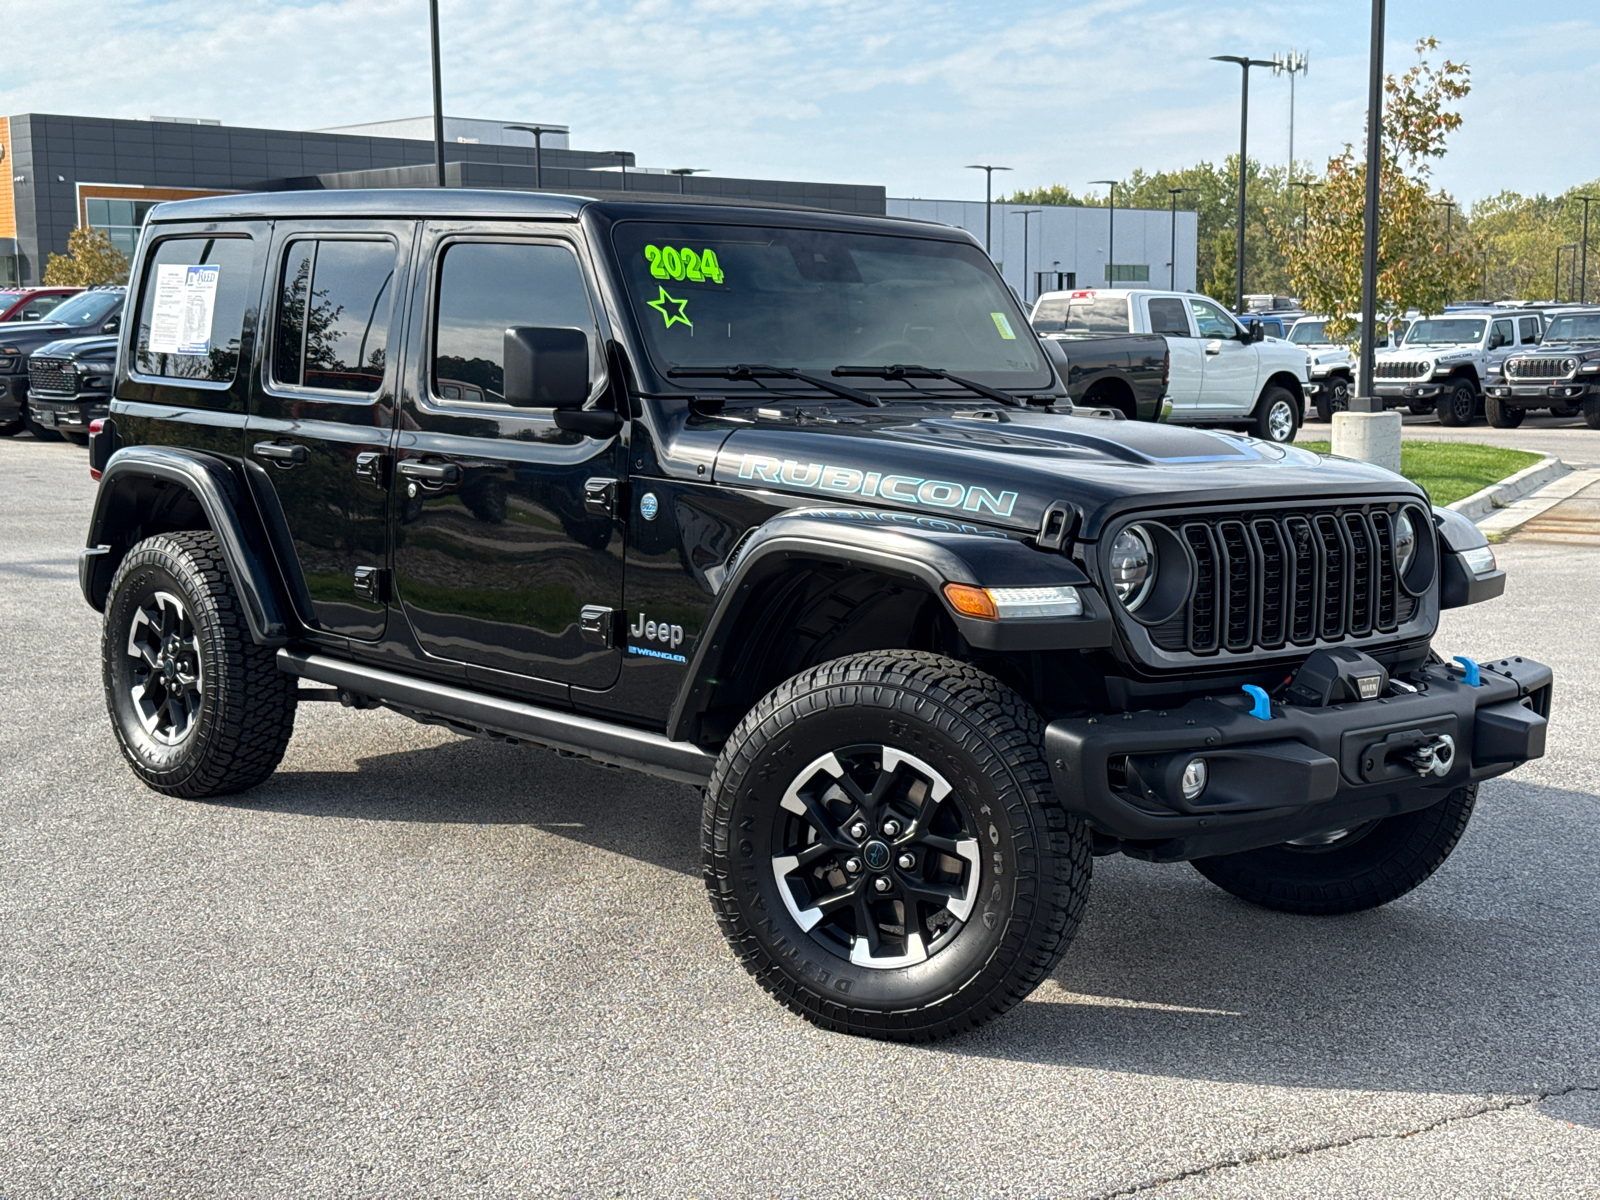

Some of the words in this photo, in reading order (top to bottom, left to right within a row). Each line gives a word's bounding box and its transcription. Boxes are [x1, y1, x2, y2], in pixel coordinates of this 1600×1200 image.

[645, 244, 724, 284] 2024
[738, 453, 1018, 517] RUBICON
[631, 613, 684, 649] Jeep
[637, 647, 686, 663] WRANGLER
[738, 814, 855, 996] DESTINATION
